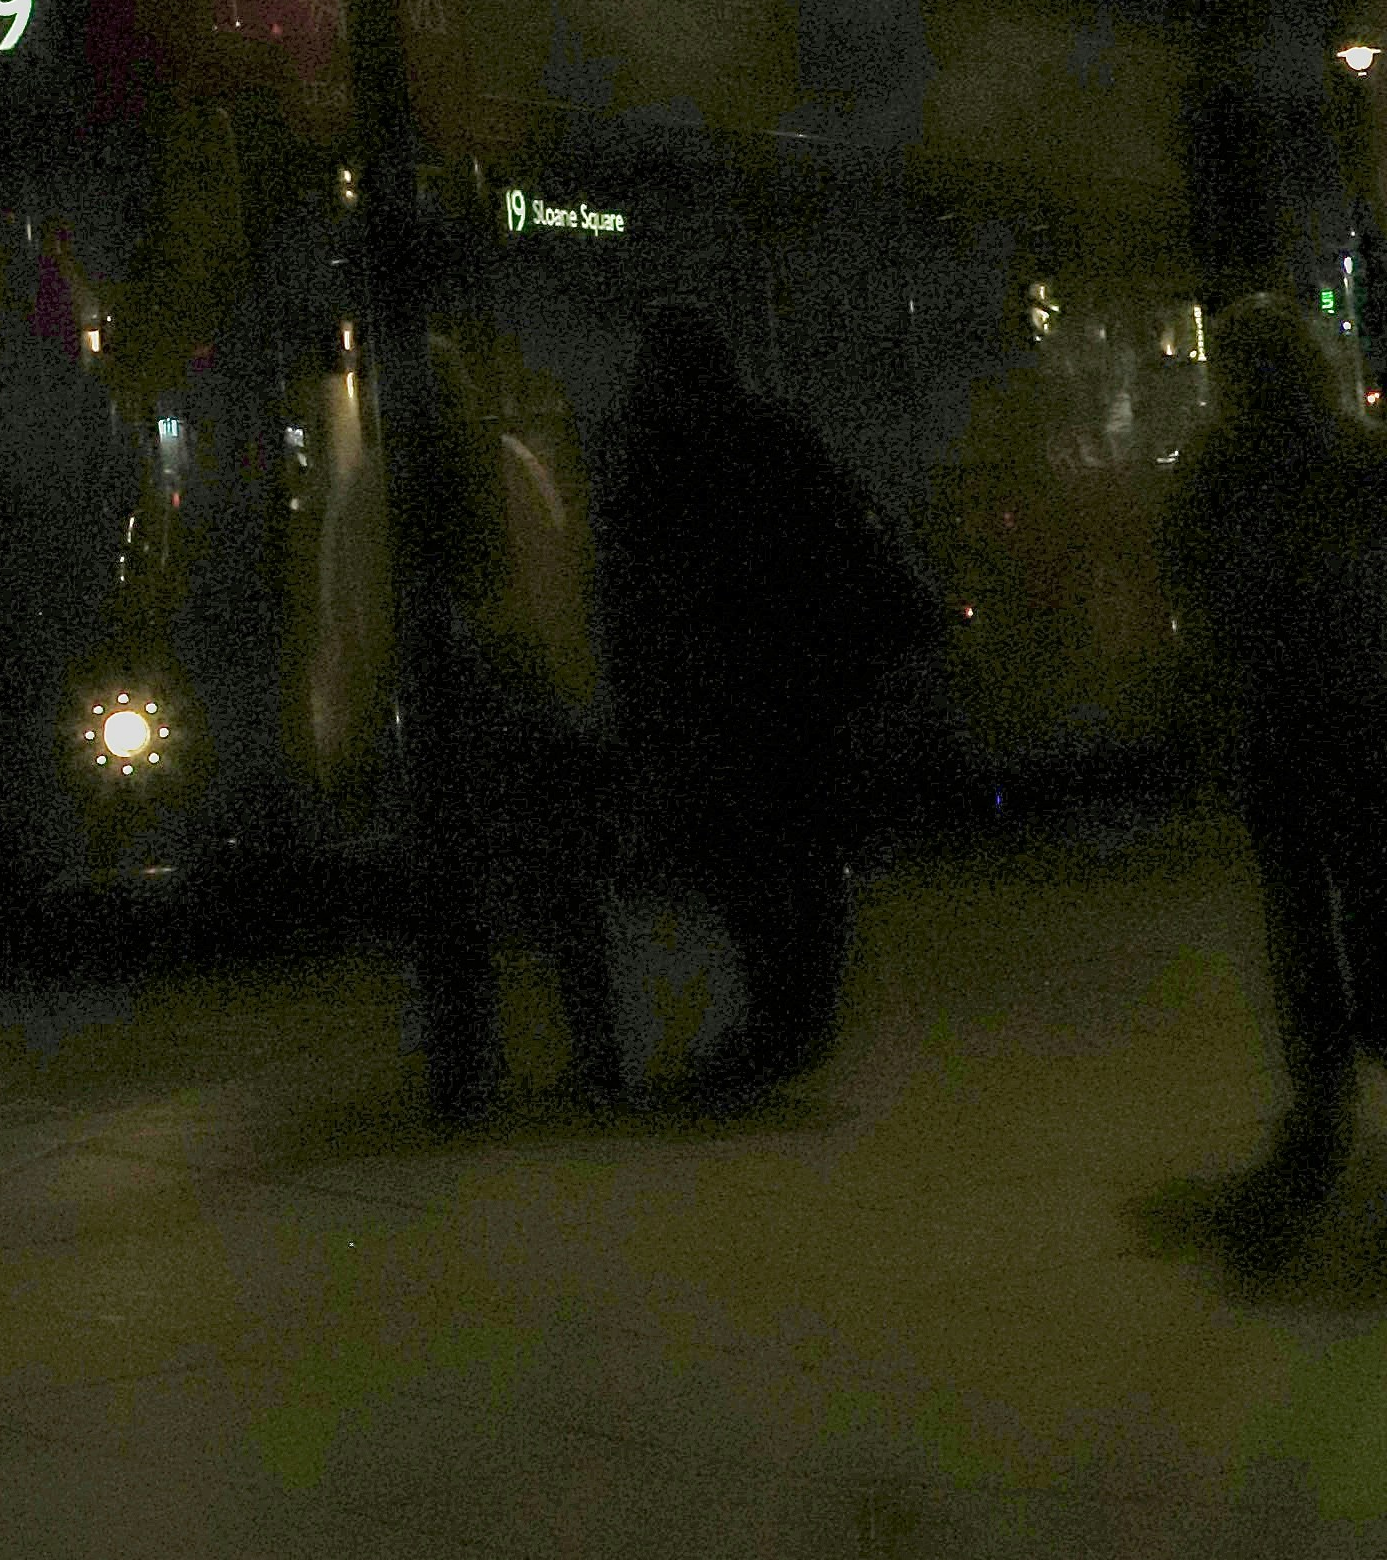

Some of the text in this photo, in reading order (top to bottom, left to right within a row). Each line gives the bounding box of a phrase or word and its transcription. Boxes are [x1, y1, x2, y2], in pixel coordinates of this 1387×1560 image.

[506, 189, 625, 237] 19 Sloane Square
